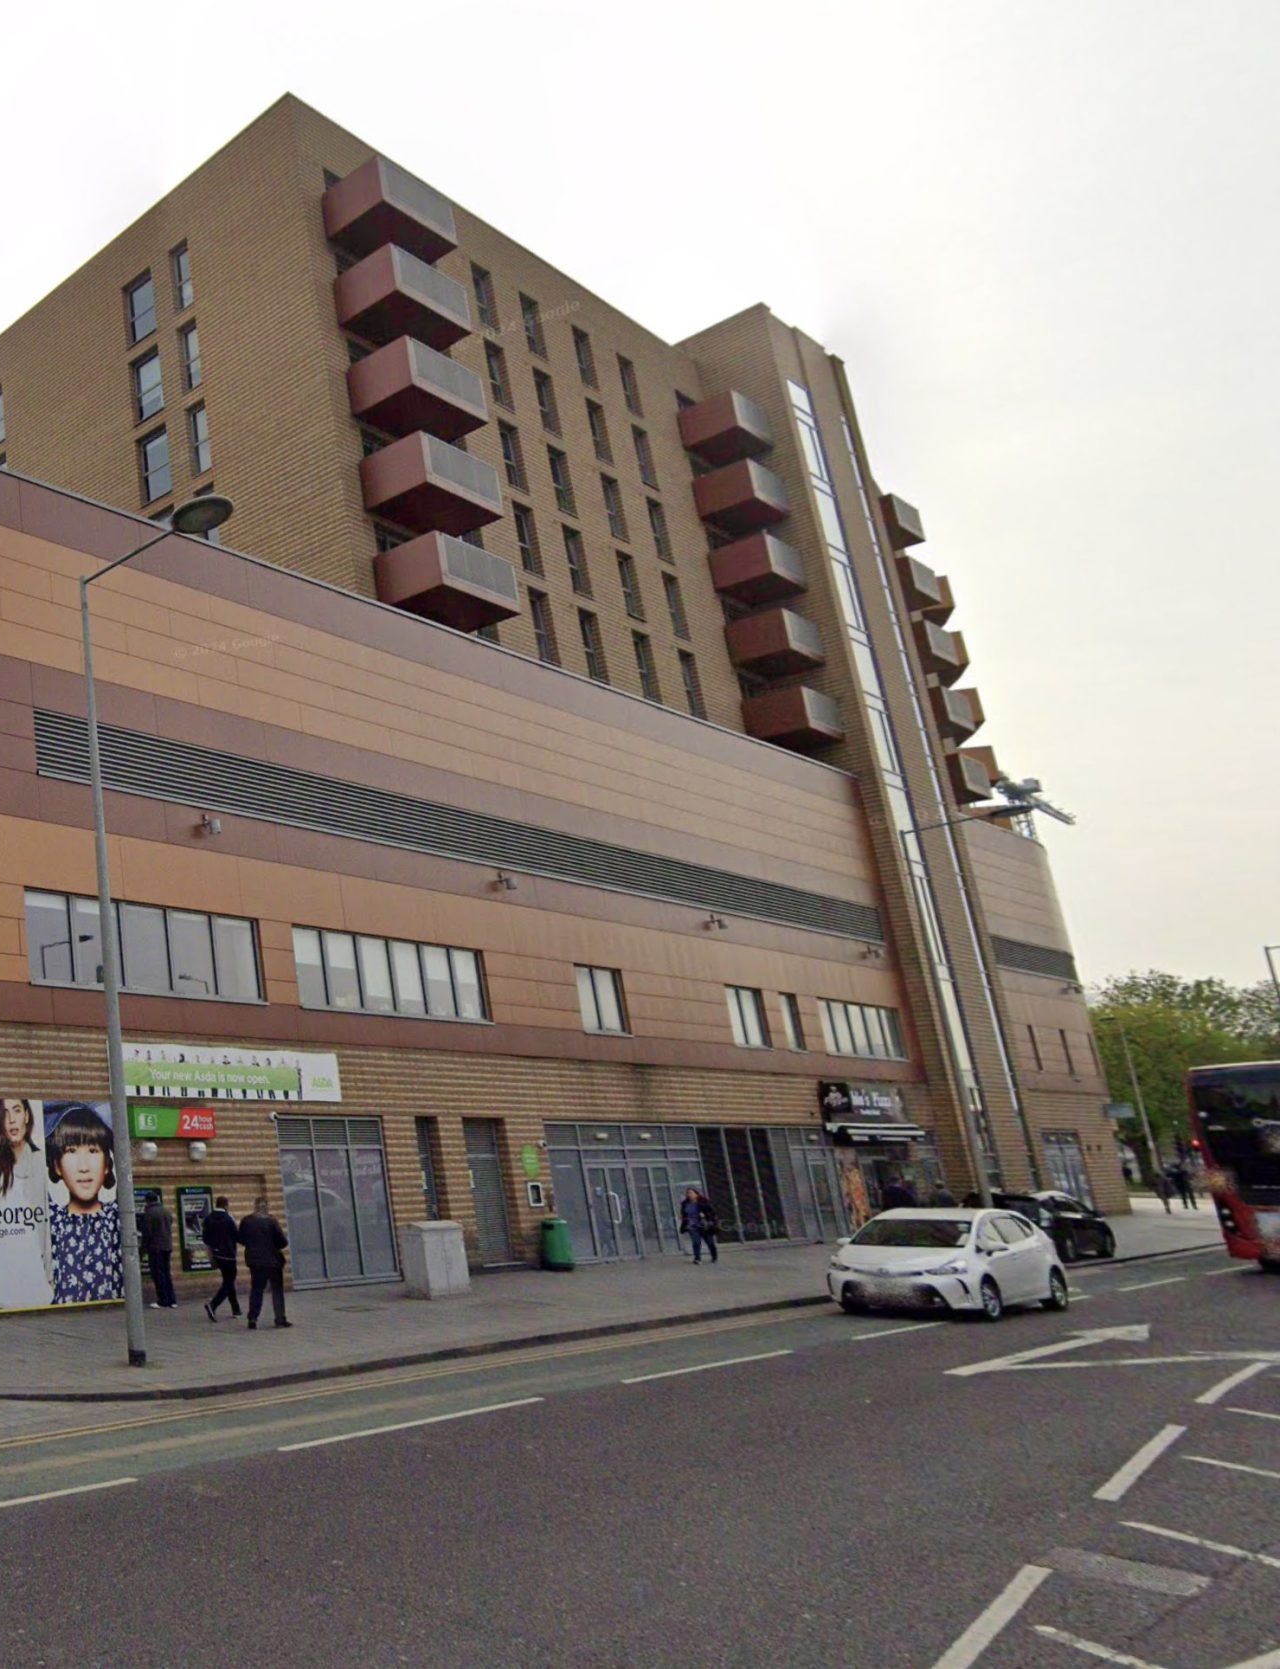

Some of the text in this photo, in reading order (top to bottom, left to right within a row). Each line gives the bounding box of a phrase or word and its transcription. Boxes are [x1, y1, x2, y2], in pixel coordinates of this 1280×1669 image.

[150, 1069, 171, 1081] Your
[173, 1072, 192, 1082] new
[194, 1071, 217, 1083] Asda
[218, 1073, 225, 1083] is
[227, 1074, 245, 1084] now
[183, 1114, 200, 1131] 24
